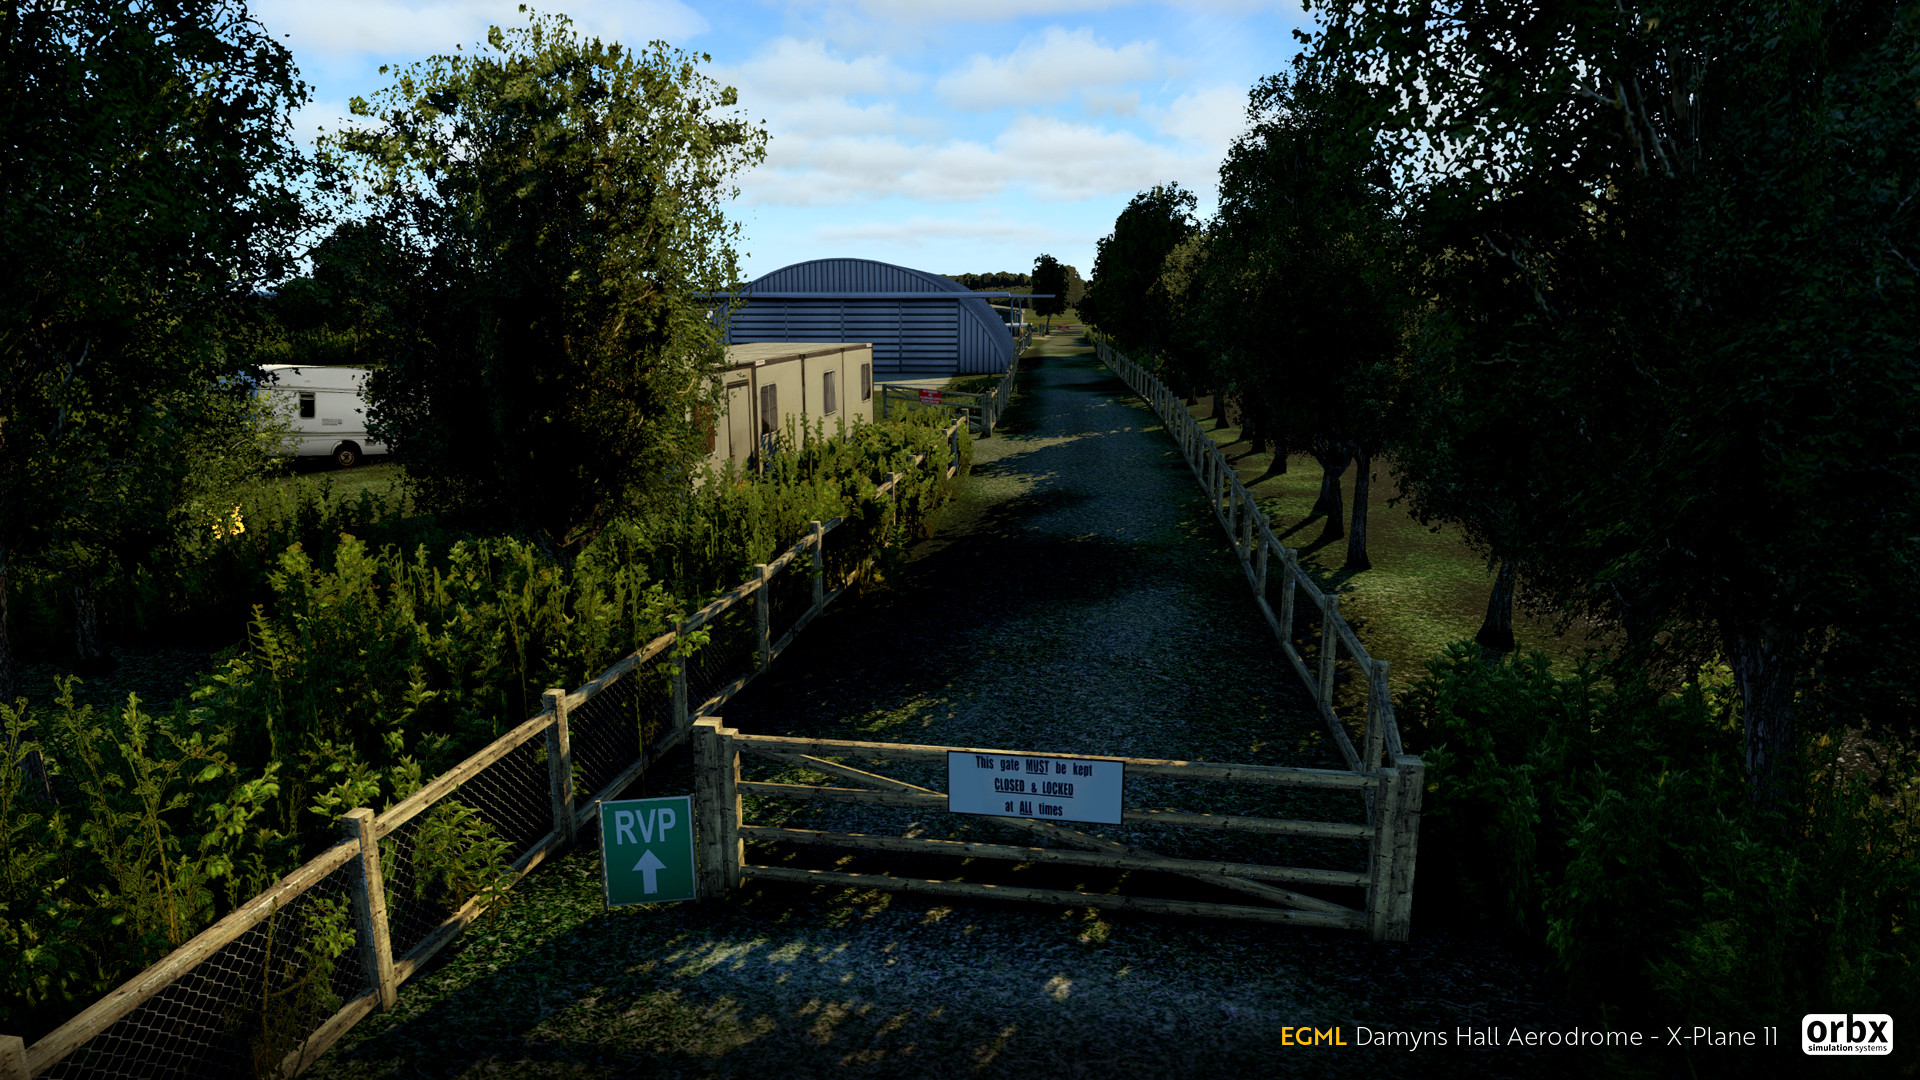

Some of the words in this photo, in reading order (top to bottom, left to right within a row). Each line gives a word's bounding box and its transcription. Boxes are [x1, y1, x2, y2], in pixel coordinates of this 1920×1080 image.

[976, 755, 994, 770] This
[1000, 759, 1020, 772] gate
[1026, 758, 1050, 775] MUST
[1055, 761, 1067, 775] be
[1073, 762, 1093, 778] kept
[994, 777, 1025, 793] CLOSED
[1031, 782, 1037, 794] &
[1042, 781, 1074, 797] LOCKED
[1005, 801, 1014, 813] at
[1019, 800, 1033, 815] ALL
[1039, 802, 1063, 817] times
[615, 808, 676, 845] RVP
